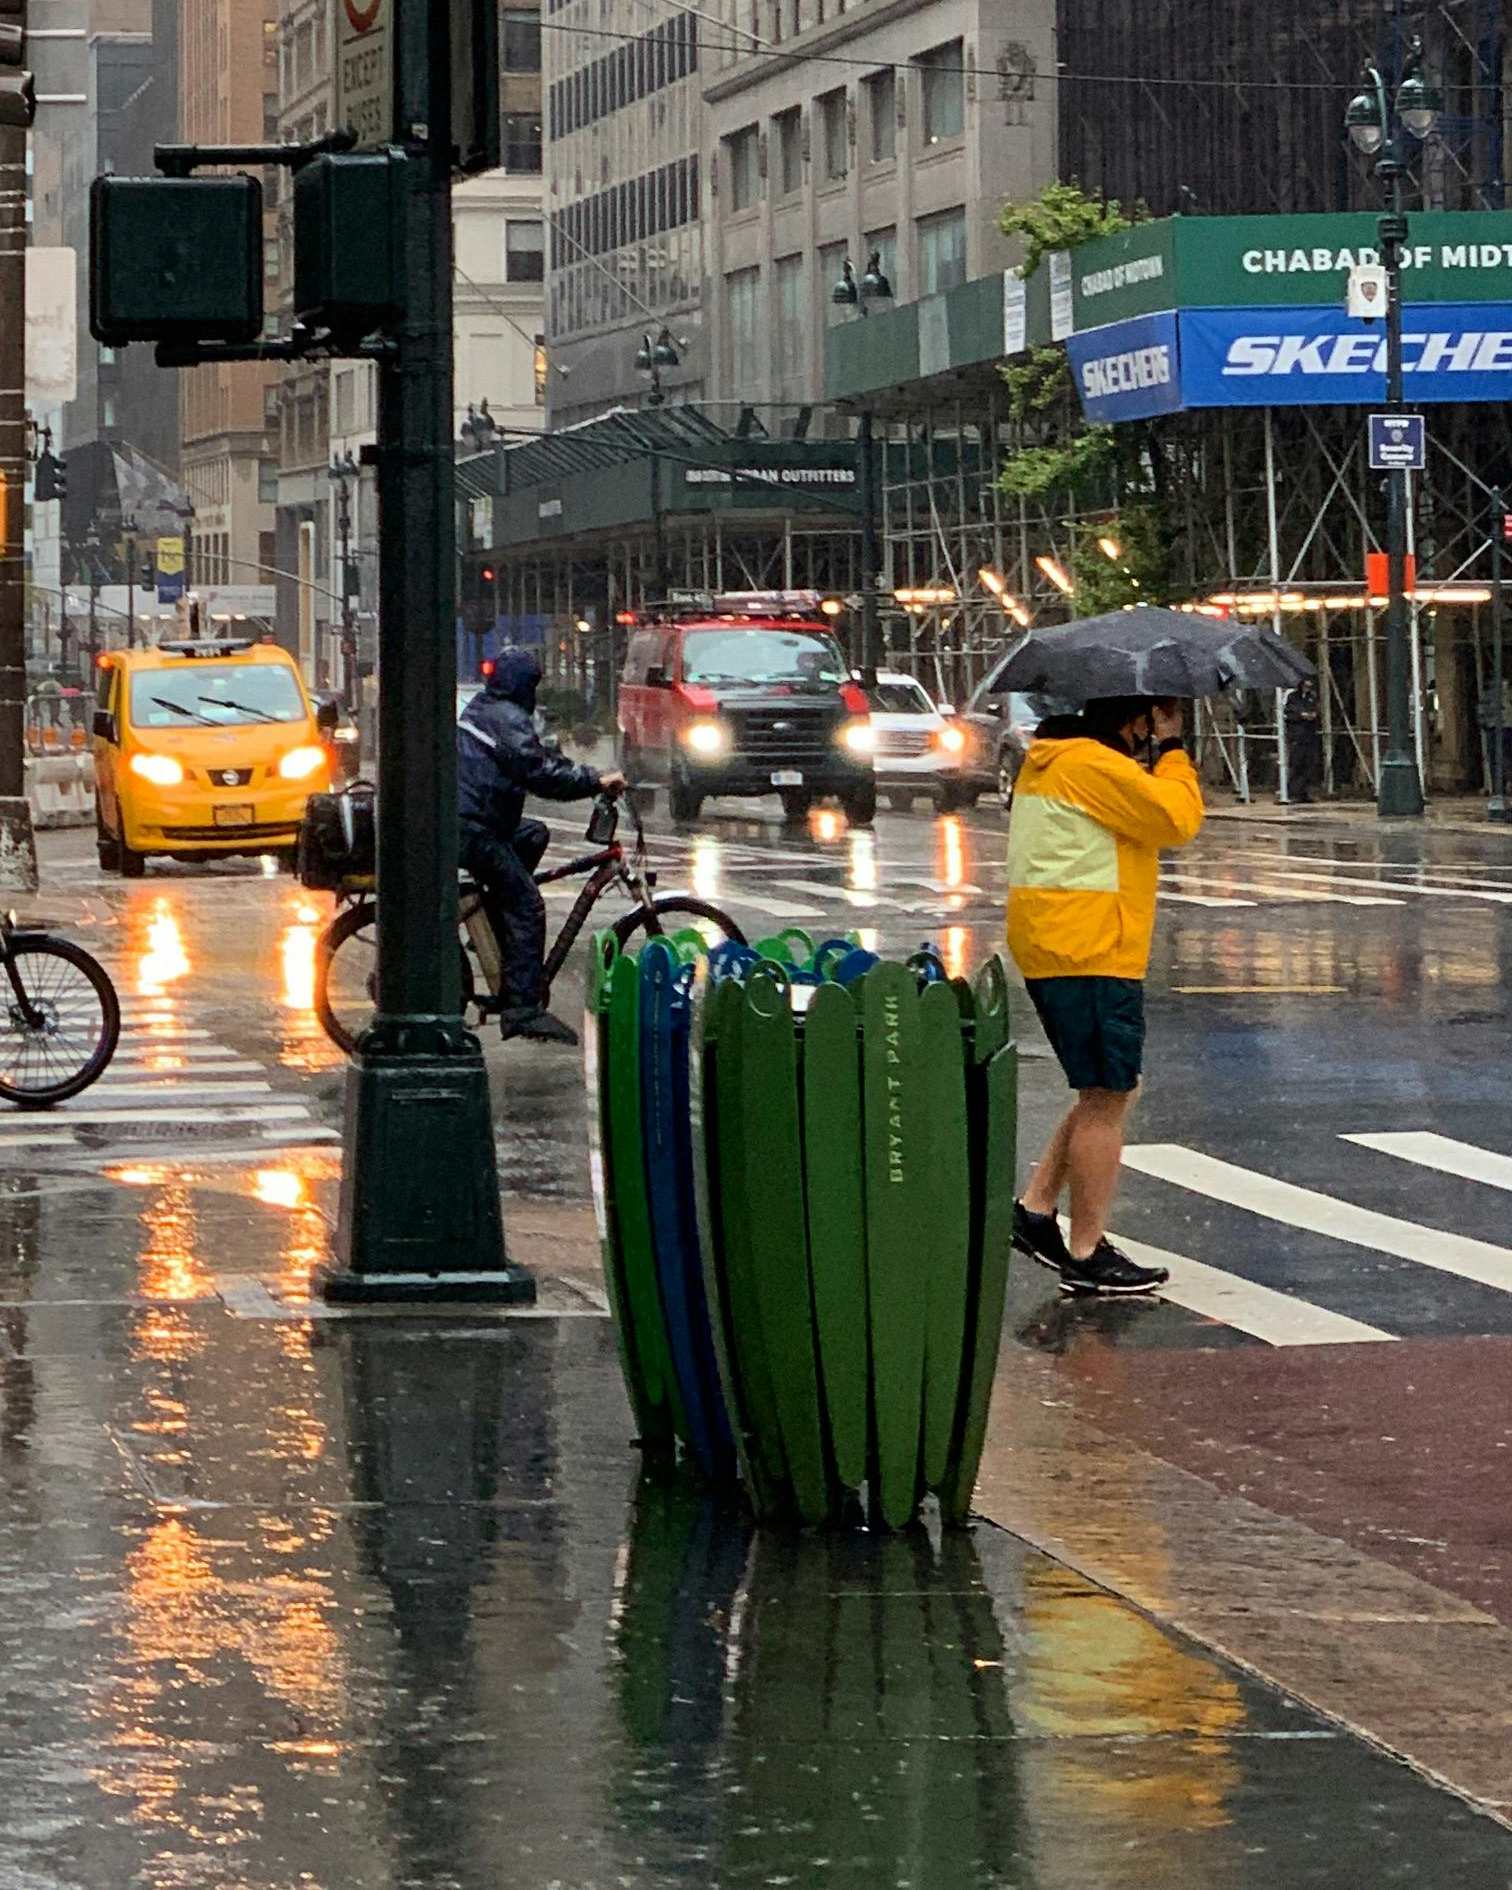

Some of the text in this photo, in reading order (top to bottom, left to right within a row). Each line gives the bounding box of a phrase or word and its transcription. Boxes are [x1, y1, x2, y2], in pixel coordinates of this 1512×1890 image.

[344, 45, 384, 95] EXCEPT
[1242, 247, 1382, 273] CHABAD
[1082, 344, 1170, 399] SKECHERS
[1221, 331, 1512, 375] SKECHE
[781, 469, 856, 483] OUTFITTERS
[885, 996, 903, 1183] BRYANT PARK
